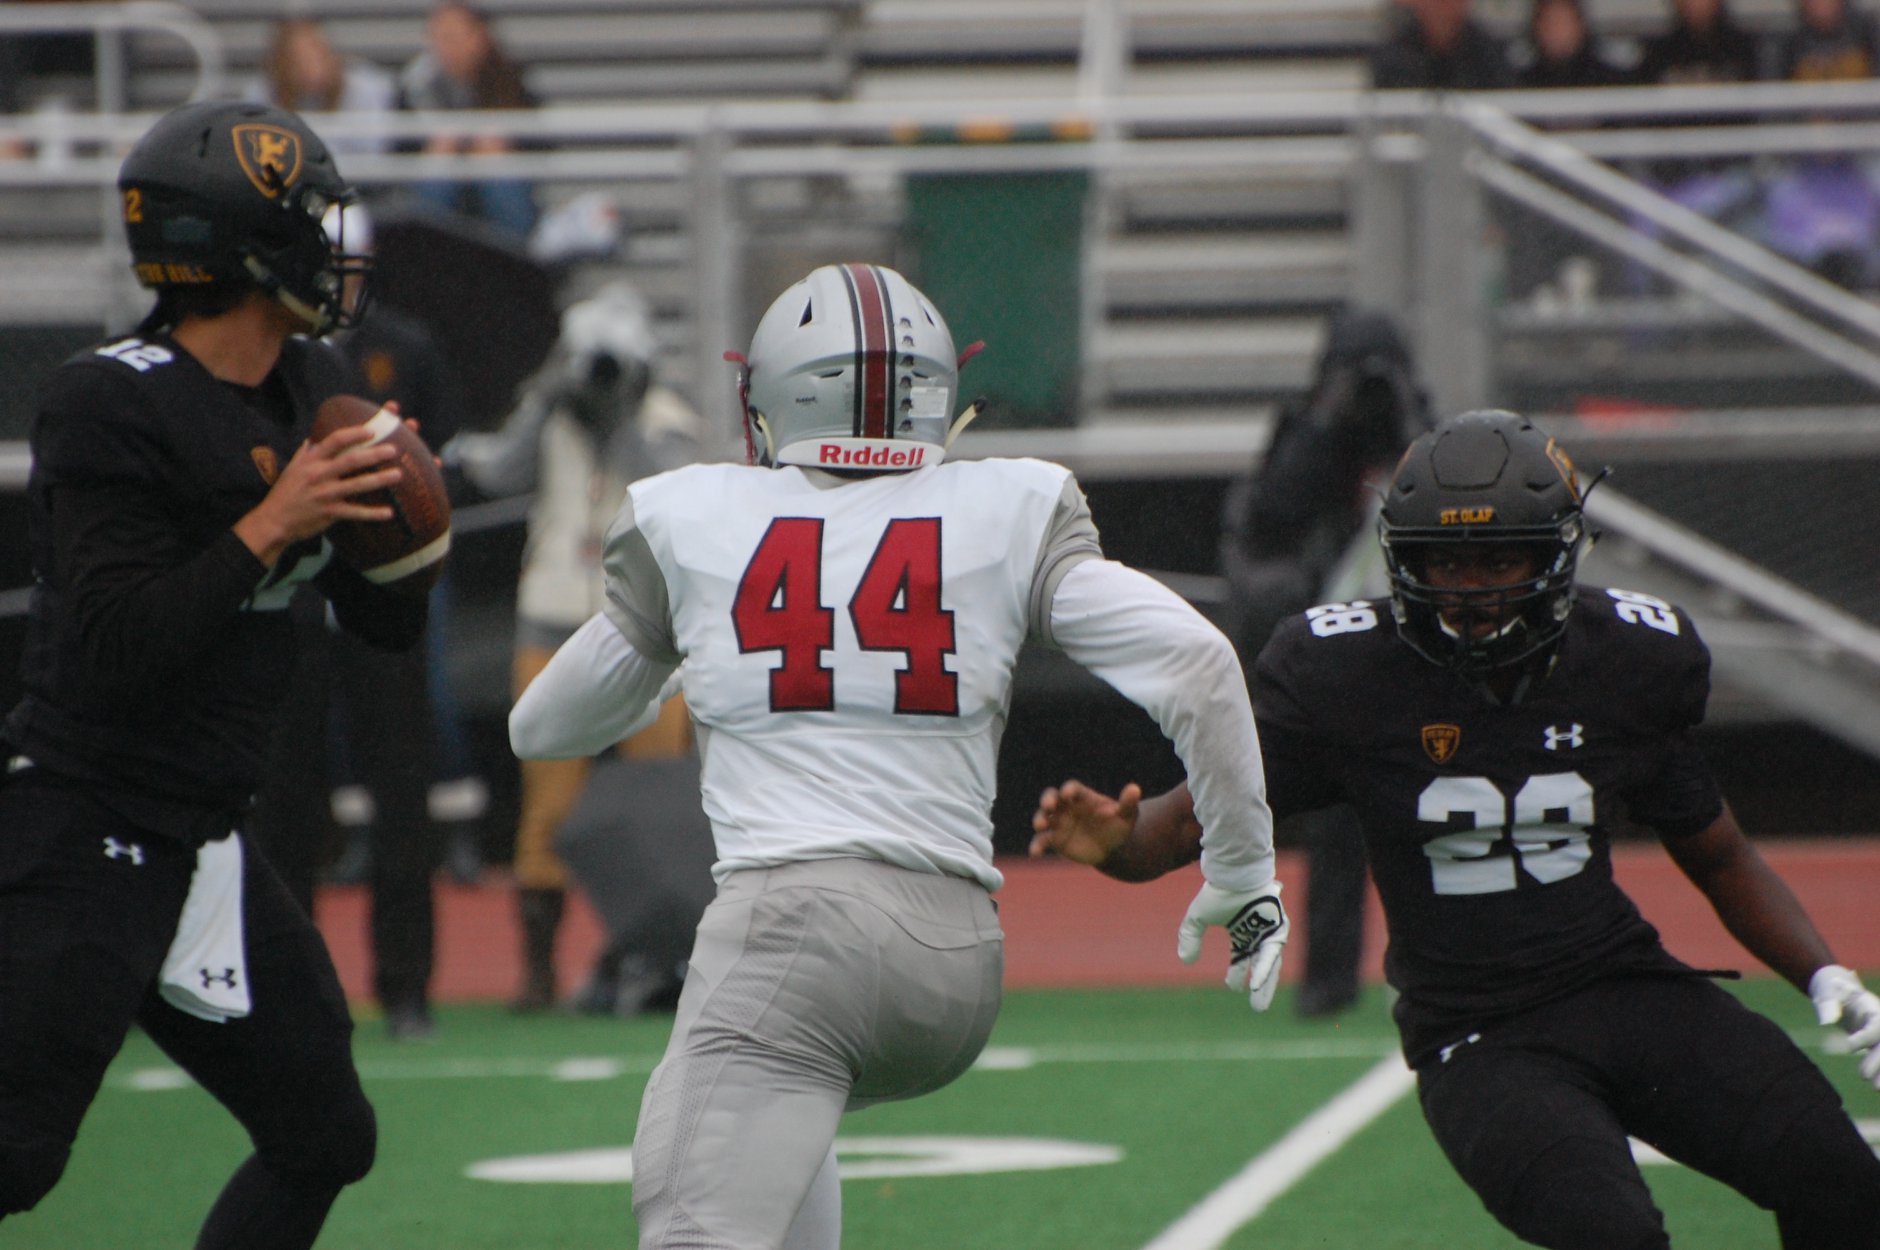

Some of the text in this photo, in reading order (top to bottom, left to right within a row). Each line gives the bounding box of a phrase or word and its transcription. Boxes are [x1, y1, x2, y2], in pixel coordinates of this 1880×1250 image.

[819, 444, 924, 466] Riddell
[1460, 505, 1494, 523] OLAF
[731, 516, 959, 717] 44
[1417, 771, 1595, 895] 28
